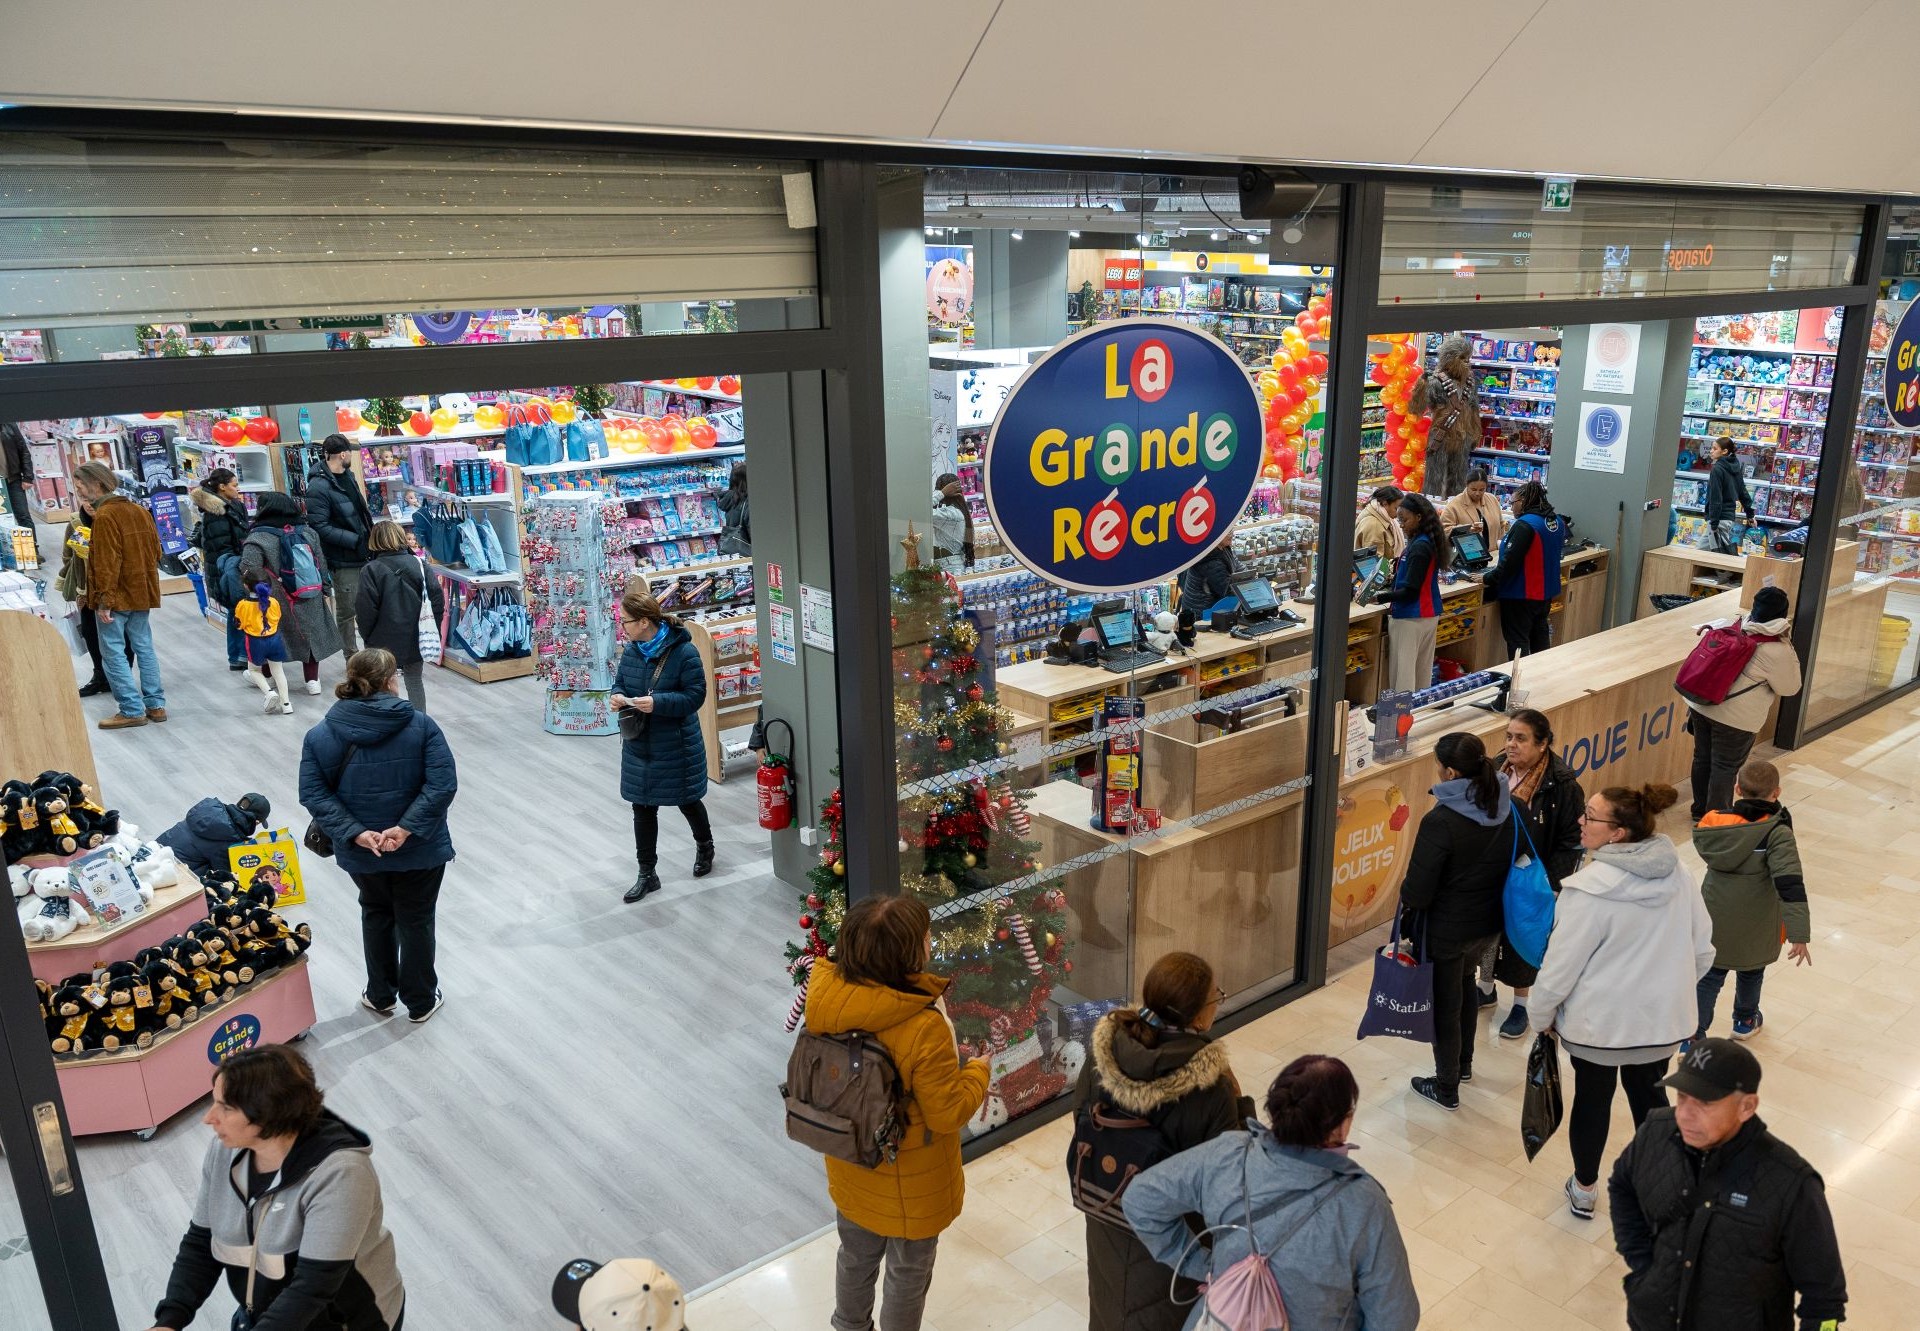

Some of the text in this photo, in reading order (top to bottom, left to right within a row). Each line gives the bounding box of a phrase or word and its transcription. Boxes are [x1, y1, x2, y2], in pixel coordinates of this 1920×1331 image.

[1106, 267, 1123, 281] LEGO
[1105, 343, 1166, 399] La
[933, 388, 952, 404] Disney
[1029, 411, 1233, 487] Grande
[1053, 474, 1210, 564] Récré
[1638, 702, 1675, 752] ICI
[1341, 821, 1385, 856] JEUX
[1388, 998, 1431, 1013] StatLab
[214, 1025, 254, 1053] Grande
[225, 1020, 239, 1035] La
